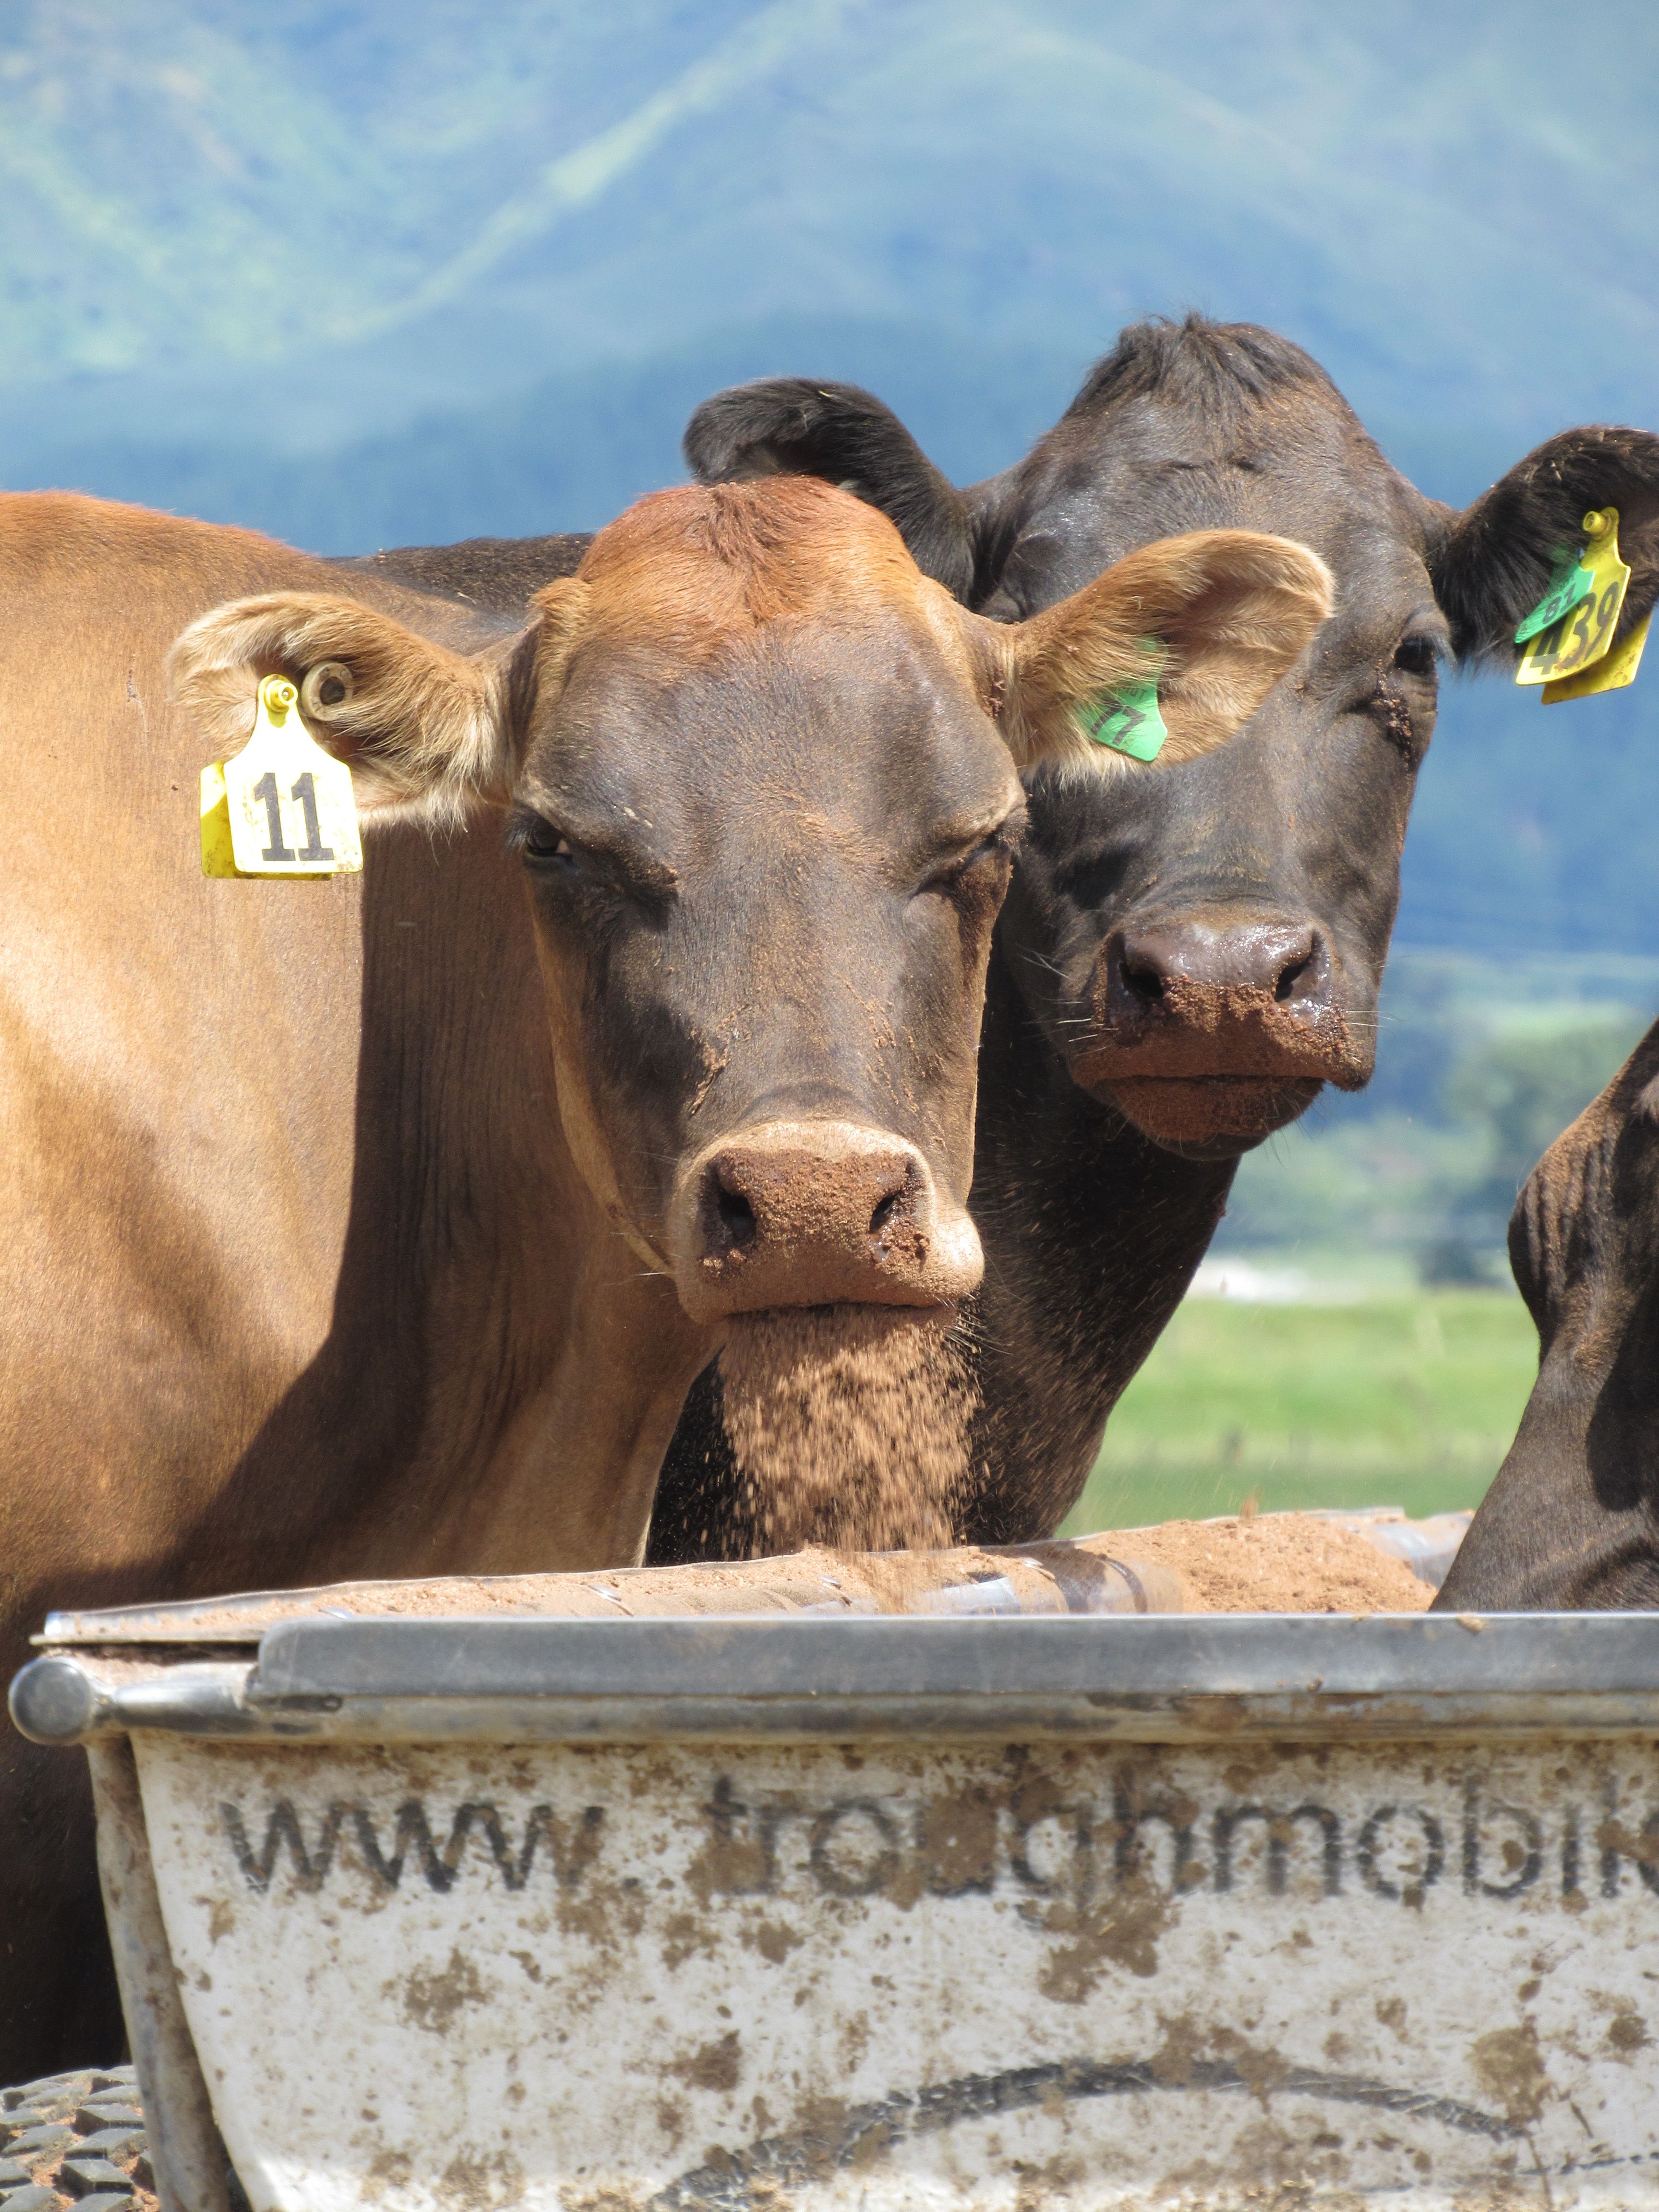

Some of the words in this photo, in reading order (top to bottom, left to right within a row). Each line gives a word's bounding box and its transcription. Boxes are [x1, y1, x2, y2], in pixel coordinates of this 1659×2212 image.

[1530, 582, 1619, 675] 439
[253, 772, 334, 861] 11
[218, 1767, 1659, 1931] www.troughmobil
